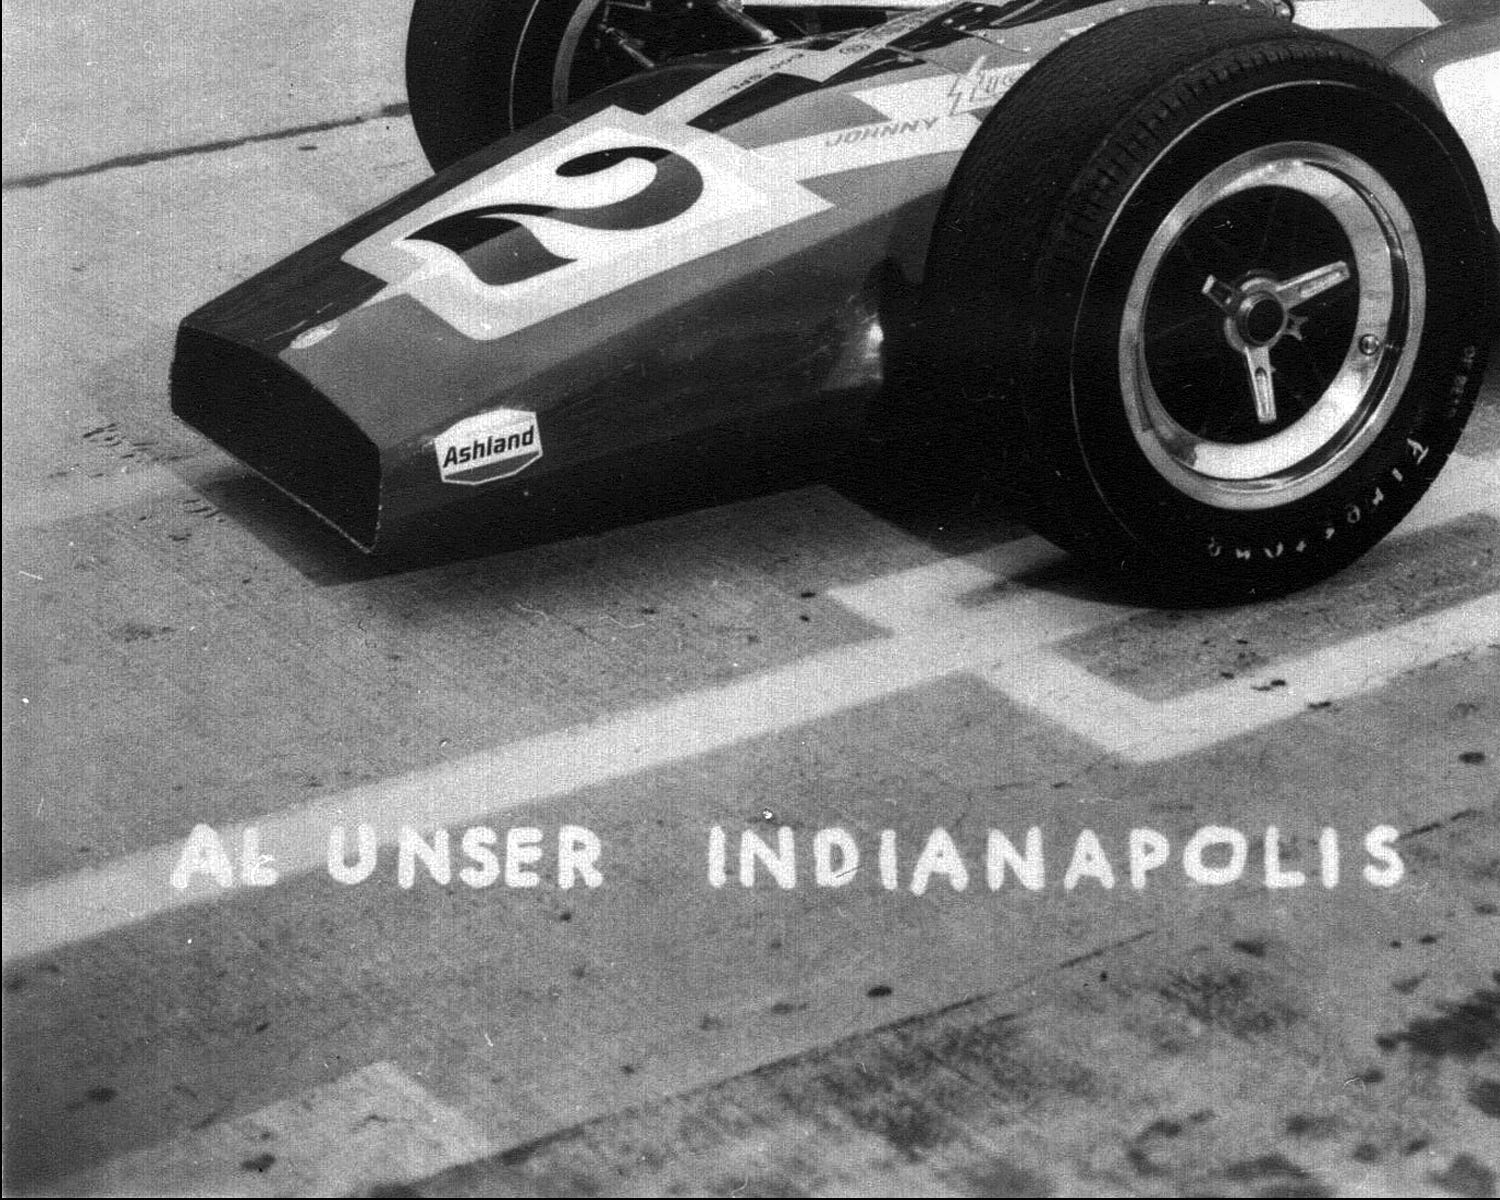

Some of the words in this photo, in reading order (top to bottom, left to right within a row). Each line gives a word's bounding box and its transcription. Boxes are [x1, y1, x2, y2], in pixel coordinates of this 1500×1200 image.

[826, 116, 938, 147] JOHNNY
[403, 146, 704, 286] 2
[443, 425, 534, 468] Ashland
